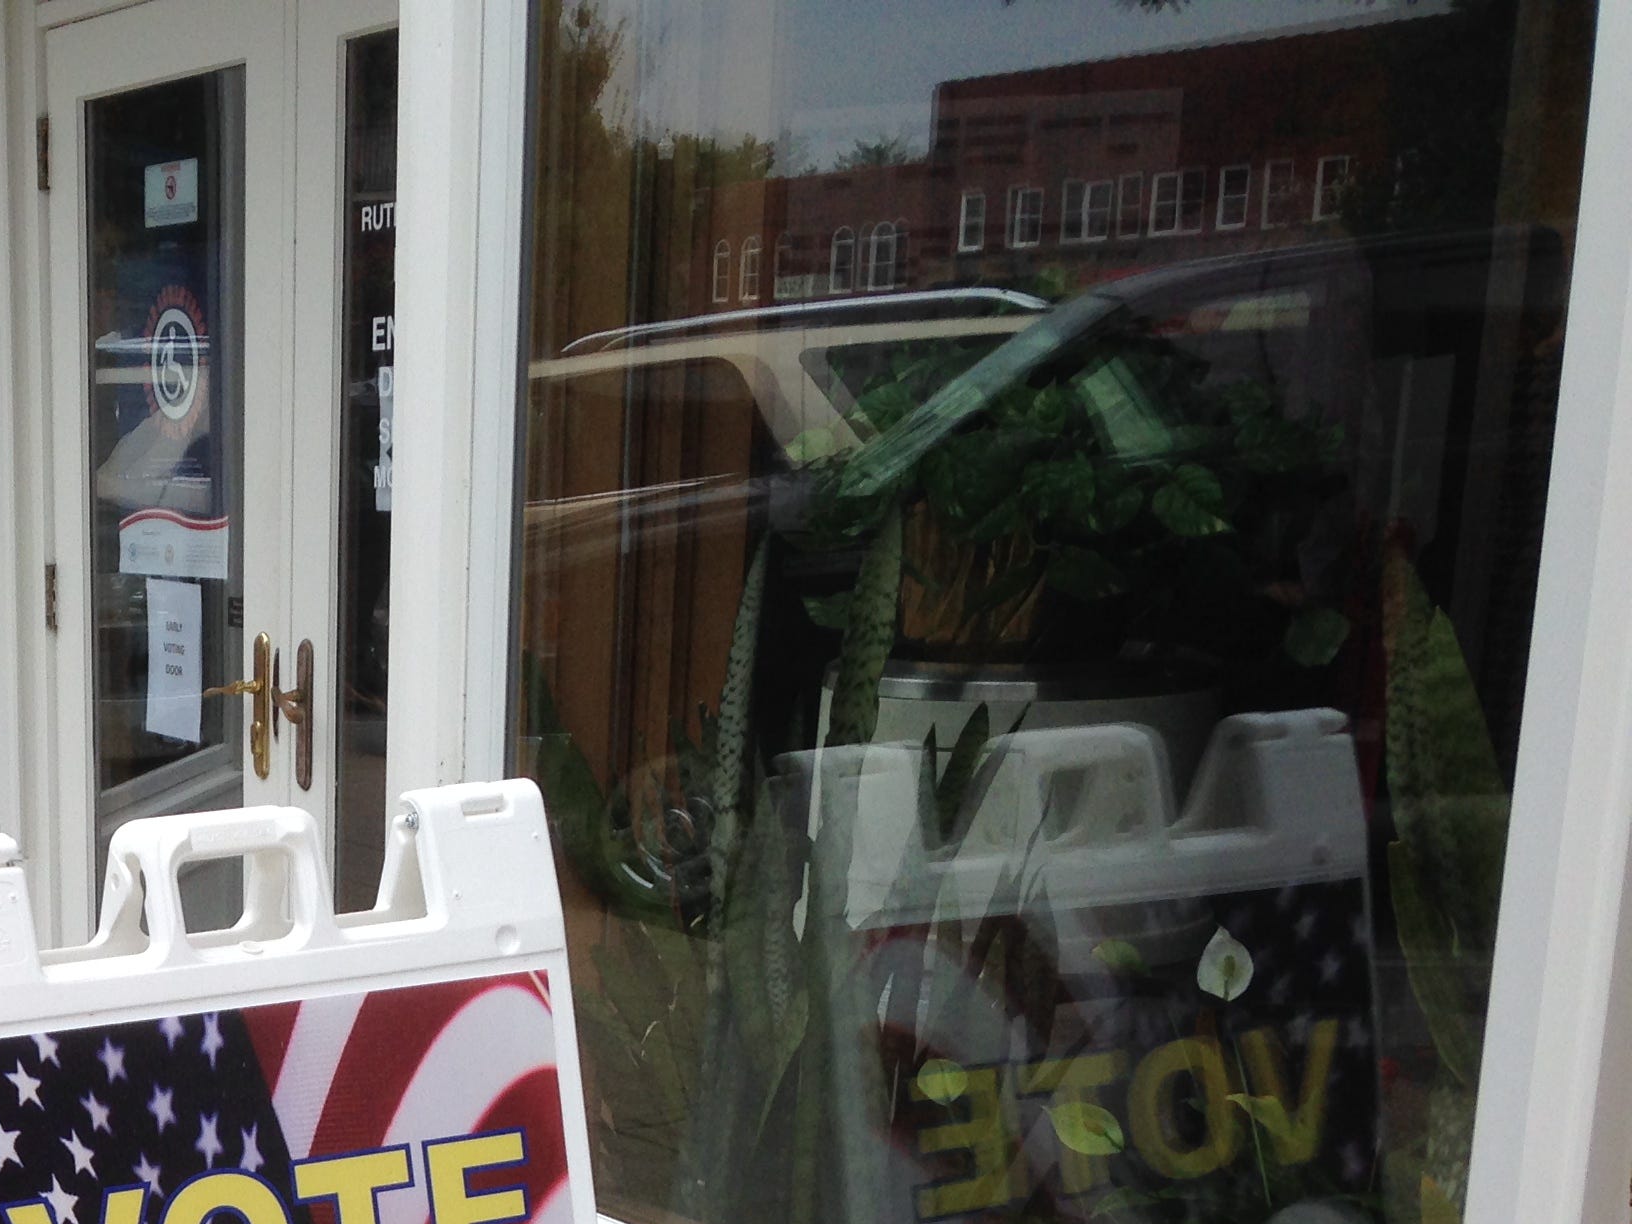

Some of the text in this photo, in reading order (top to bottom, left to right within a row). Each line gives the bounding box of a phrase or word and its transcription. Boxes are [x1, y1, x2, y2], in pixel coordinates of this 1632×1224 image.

[361, 202, 396, 232] RUT
[163, 640, 185, 656] VOTING
[165, 664, 184, 677] DOOR
